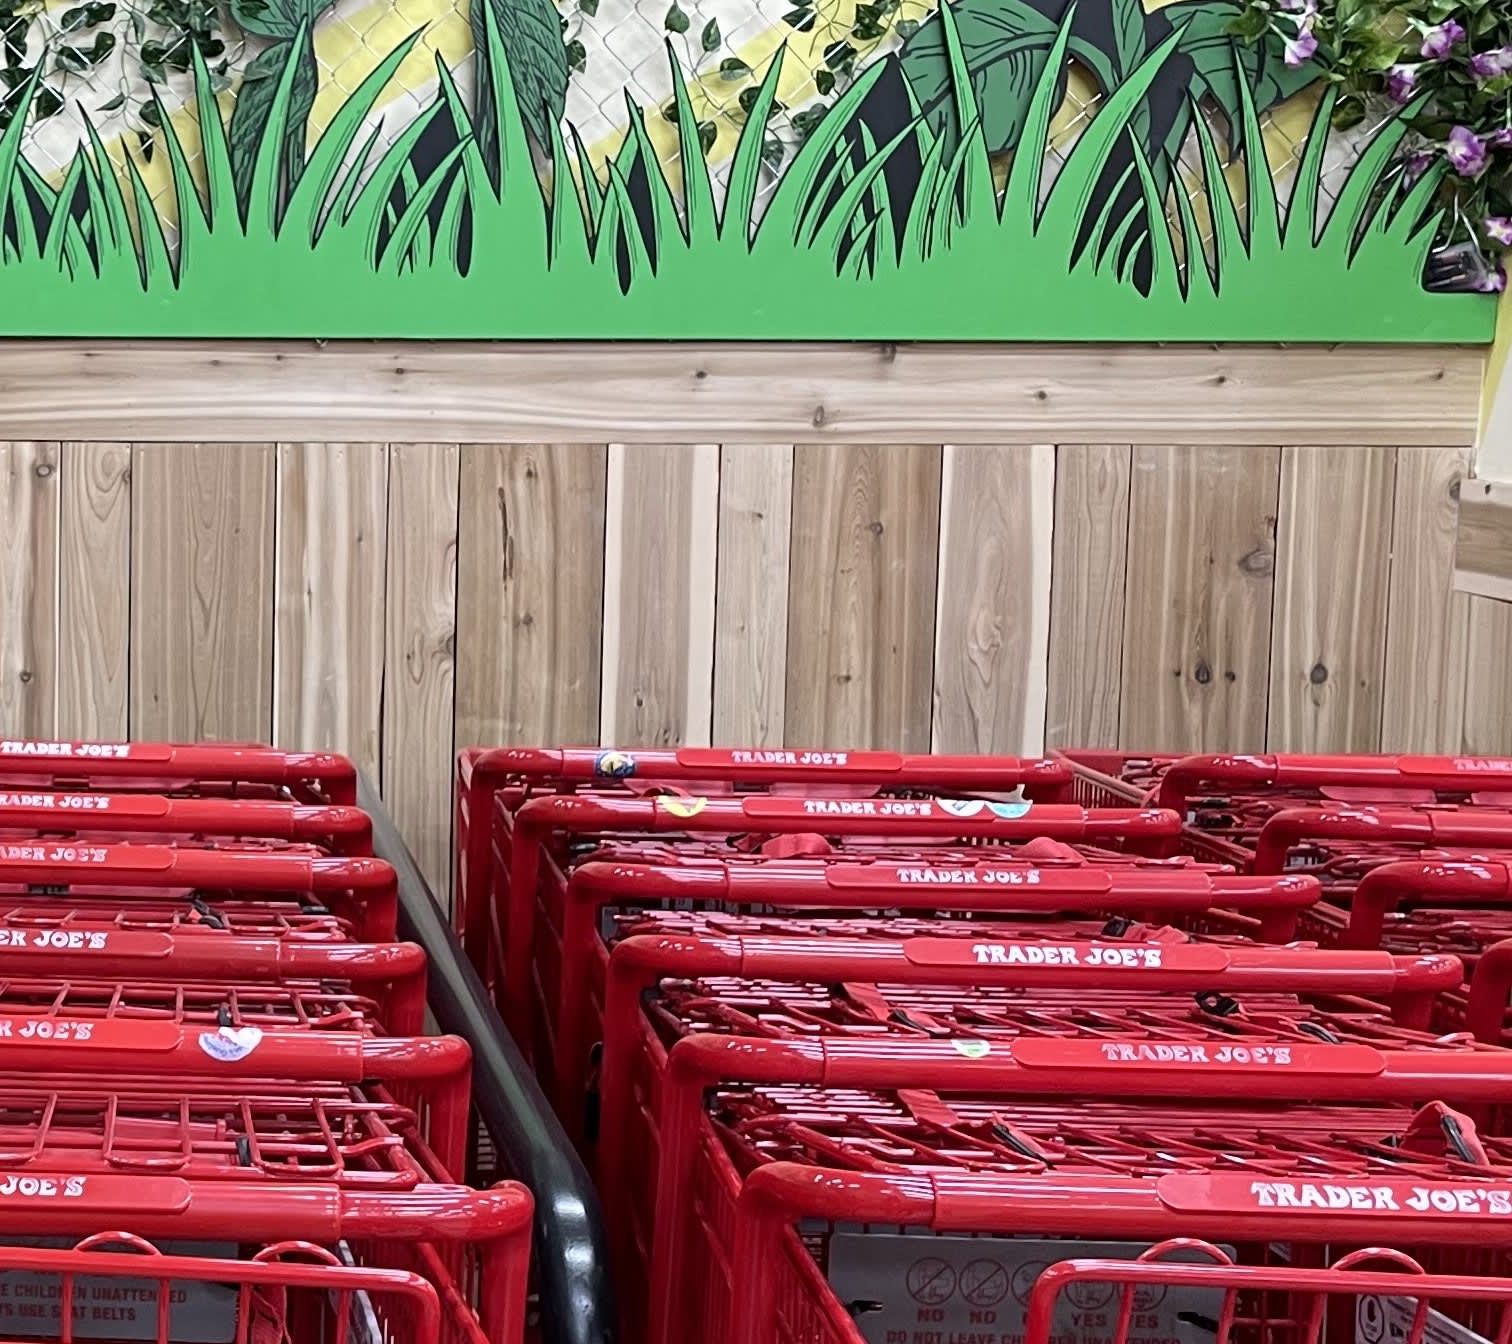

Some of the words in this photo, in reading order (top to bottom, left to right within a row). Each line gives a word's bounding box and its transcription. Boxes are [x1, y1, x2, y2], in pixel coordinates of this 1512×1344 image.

[0, 742, 73, 756] TRADER
[76, 743, 129, 758] JOE'S
[732, 751, 796, 764] TRADER
[801, 752, 847, 765] JOE'S
[58, 794, 110, 809] JOE'S
[804, 800, 874, 815] TRADER
[881, 801, 932, 817] JOE'S
[51, 846, 107, 862] JOE'S
[897, 869, 978, 883] TRADER
[983, 870, 1039, 884] JOE'S
[33, 930, 108, 949] JOE'S
[972, 943, 1080, 965] TRADER
[1085, 948, 1162, 968] JOE'S
[18, 1021, 94, 1040] JOE'S
[1101, 1043, 1209, 1063] TRADER
[1214, 1047, 1291, 1065] JOE'S
[1250, 1182, 1400, 1210] TRADER
[1405, 1187, 1511, 1213] JOE'S
[91, 1287, 187, 1303] UNATTENED
[918, 1309, 944, 1323] NO
[969, 1311, 996, 1325] NO
